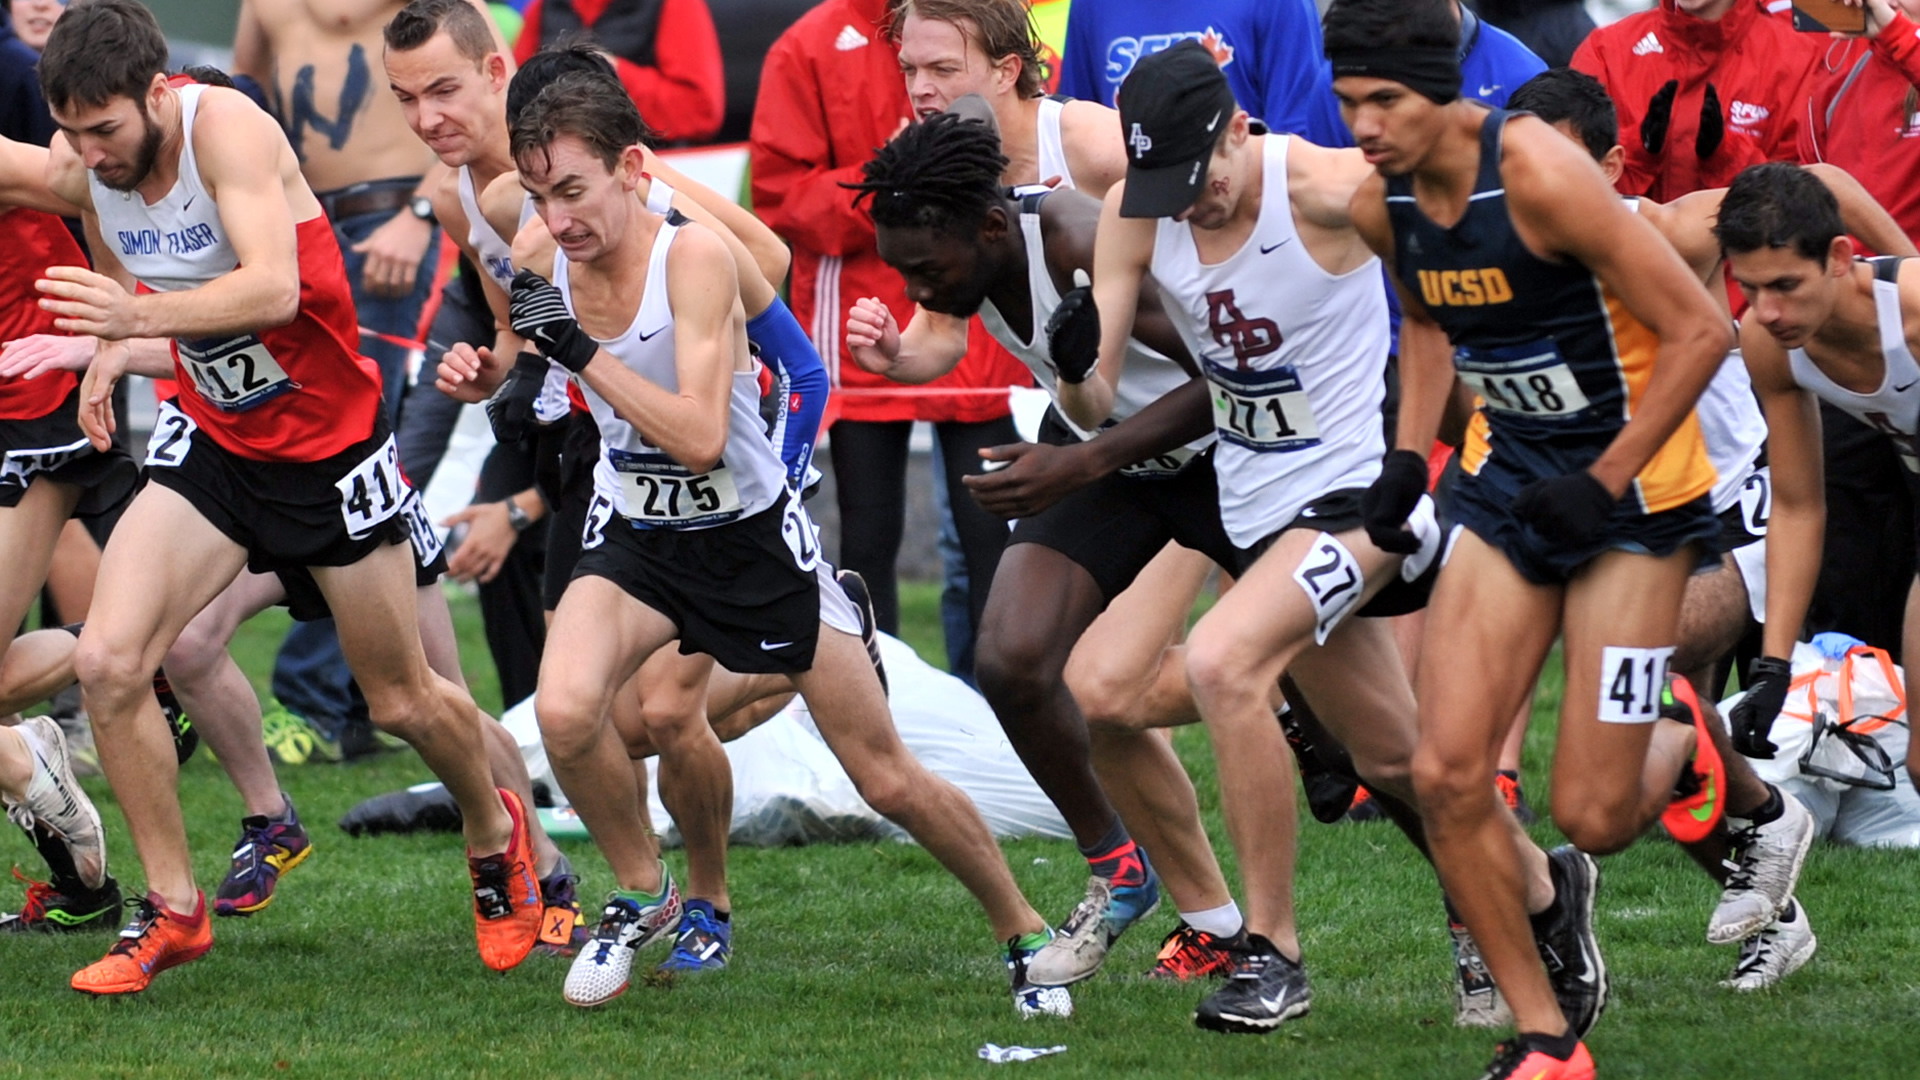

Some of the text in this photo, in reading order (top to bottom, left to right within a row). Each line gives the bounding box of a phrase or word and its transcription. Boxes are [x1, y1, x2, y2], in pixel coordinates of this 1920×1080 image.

[118, 229, 162, 255] SIMON
[1417, 267, 1514, 306] UCSD
[191, 353, 269, 400] 412
[1482, 373, 1565, 412] 418
[1220, 390, 1297, 438] 271
[635, 475, 721, 517] 275
[1609, 657, 1672, 715] 41
